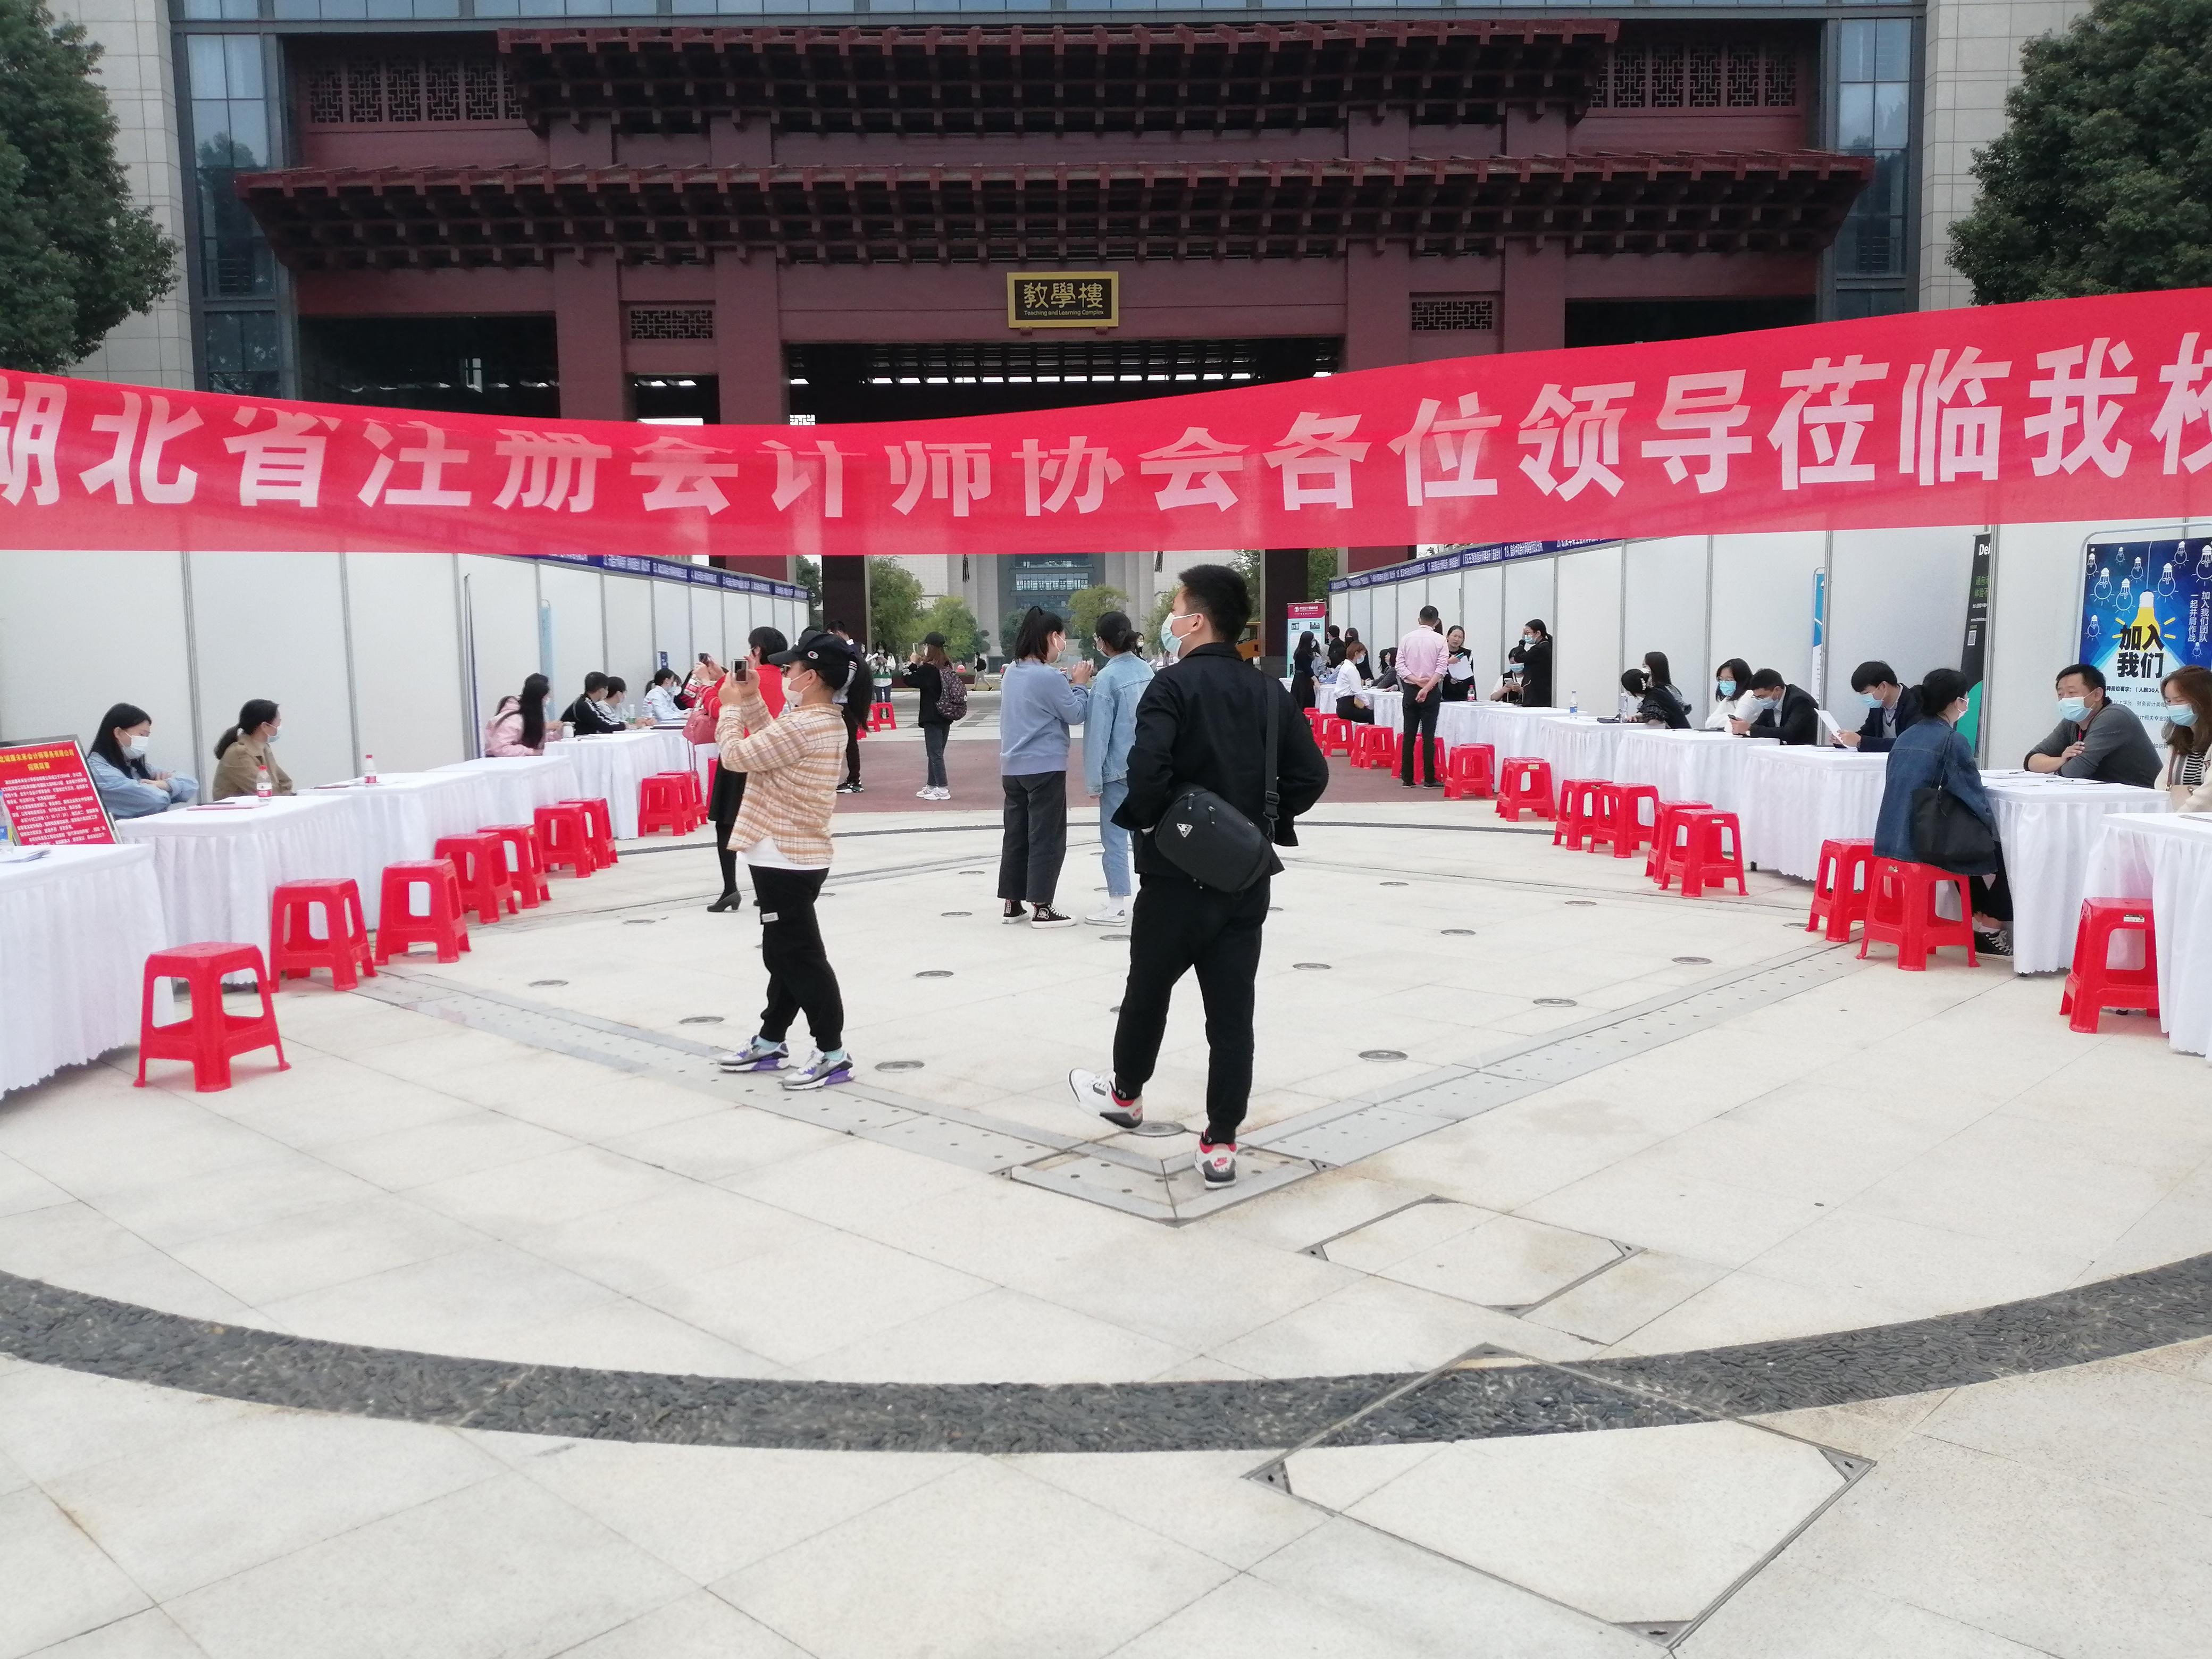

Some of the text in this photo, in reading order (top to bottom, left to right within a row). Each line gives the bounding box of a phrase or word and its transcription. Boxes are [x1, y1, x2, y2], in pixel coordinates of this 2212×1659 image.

[2188, 593, 2199, 642] 一起并肩作战
[2199, 591, 2210, 642] 加入我们团队
[2118, 624, 2165, 651] 加入
[2117, 652, 2164, 678] 我们
